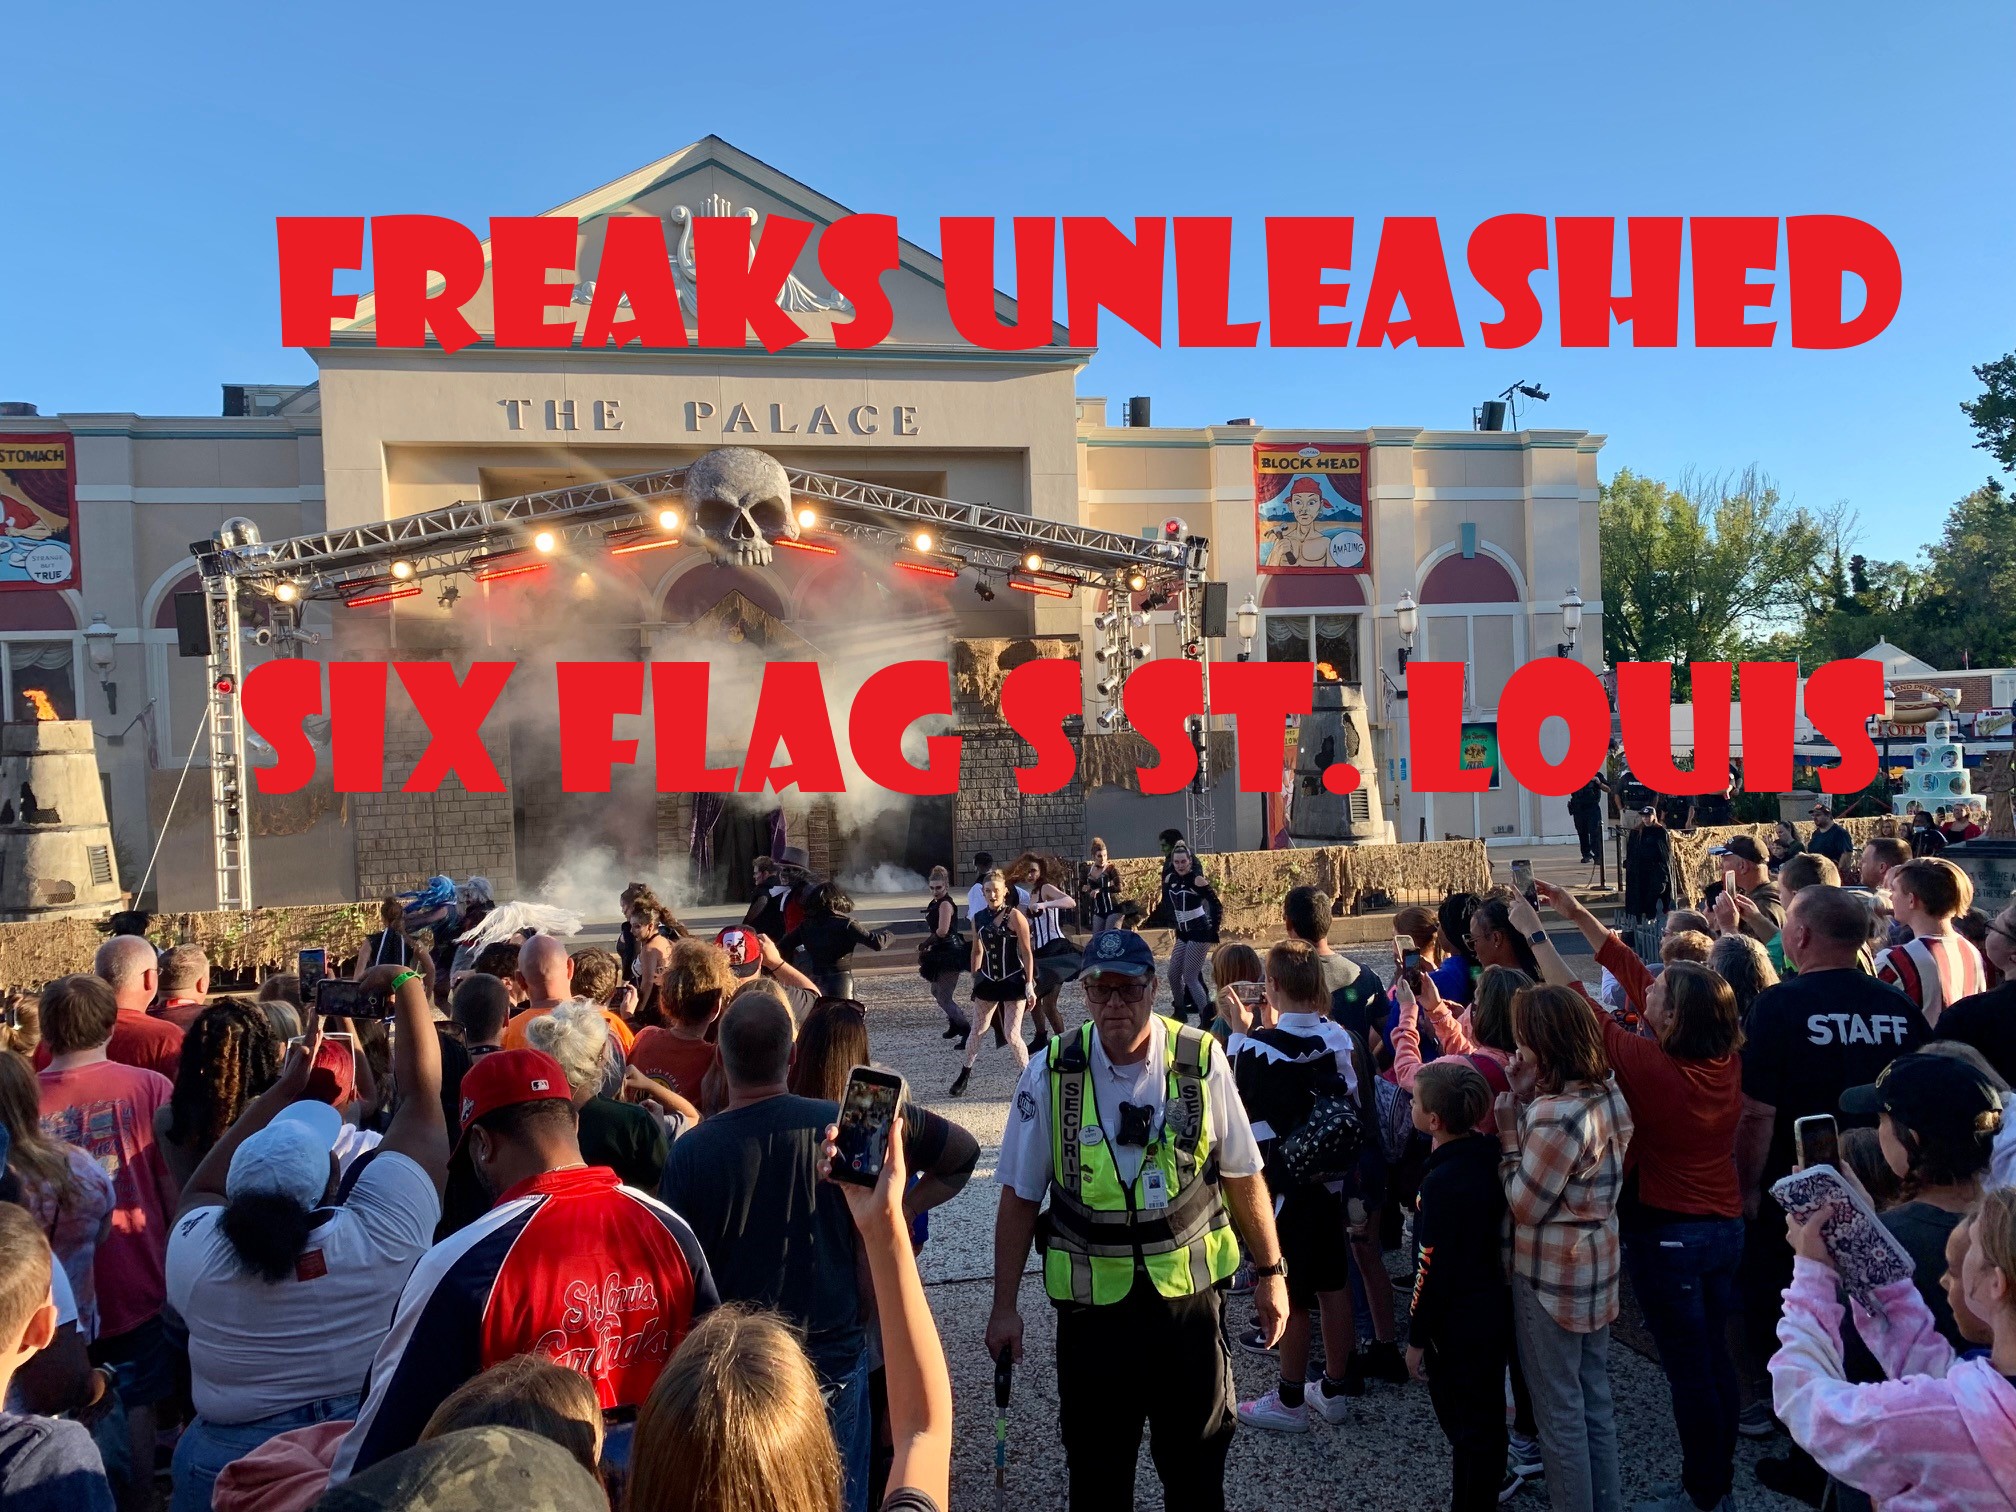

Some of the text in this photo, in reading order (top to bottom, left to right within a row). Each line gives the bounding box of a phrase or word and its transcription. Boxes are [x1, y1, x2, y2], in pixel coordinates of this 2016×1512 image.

[502, 399, 922, 436] THE PALACE
[0, 449, 65, 463] STOMACH
[1261, 457, 1360, 470] BLOCK HEAD
[1332, 542, 1364, 555] AMAZING
[32, 554, 64, 562] STRANGE
[34, 570, 63, 580] TRUE
[1894, 684, 1938, 695] AND PRIZE
[1807, 1013, 1909, 1046] STAFF
[562, 1271, 658, 1334] St. Louis
